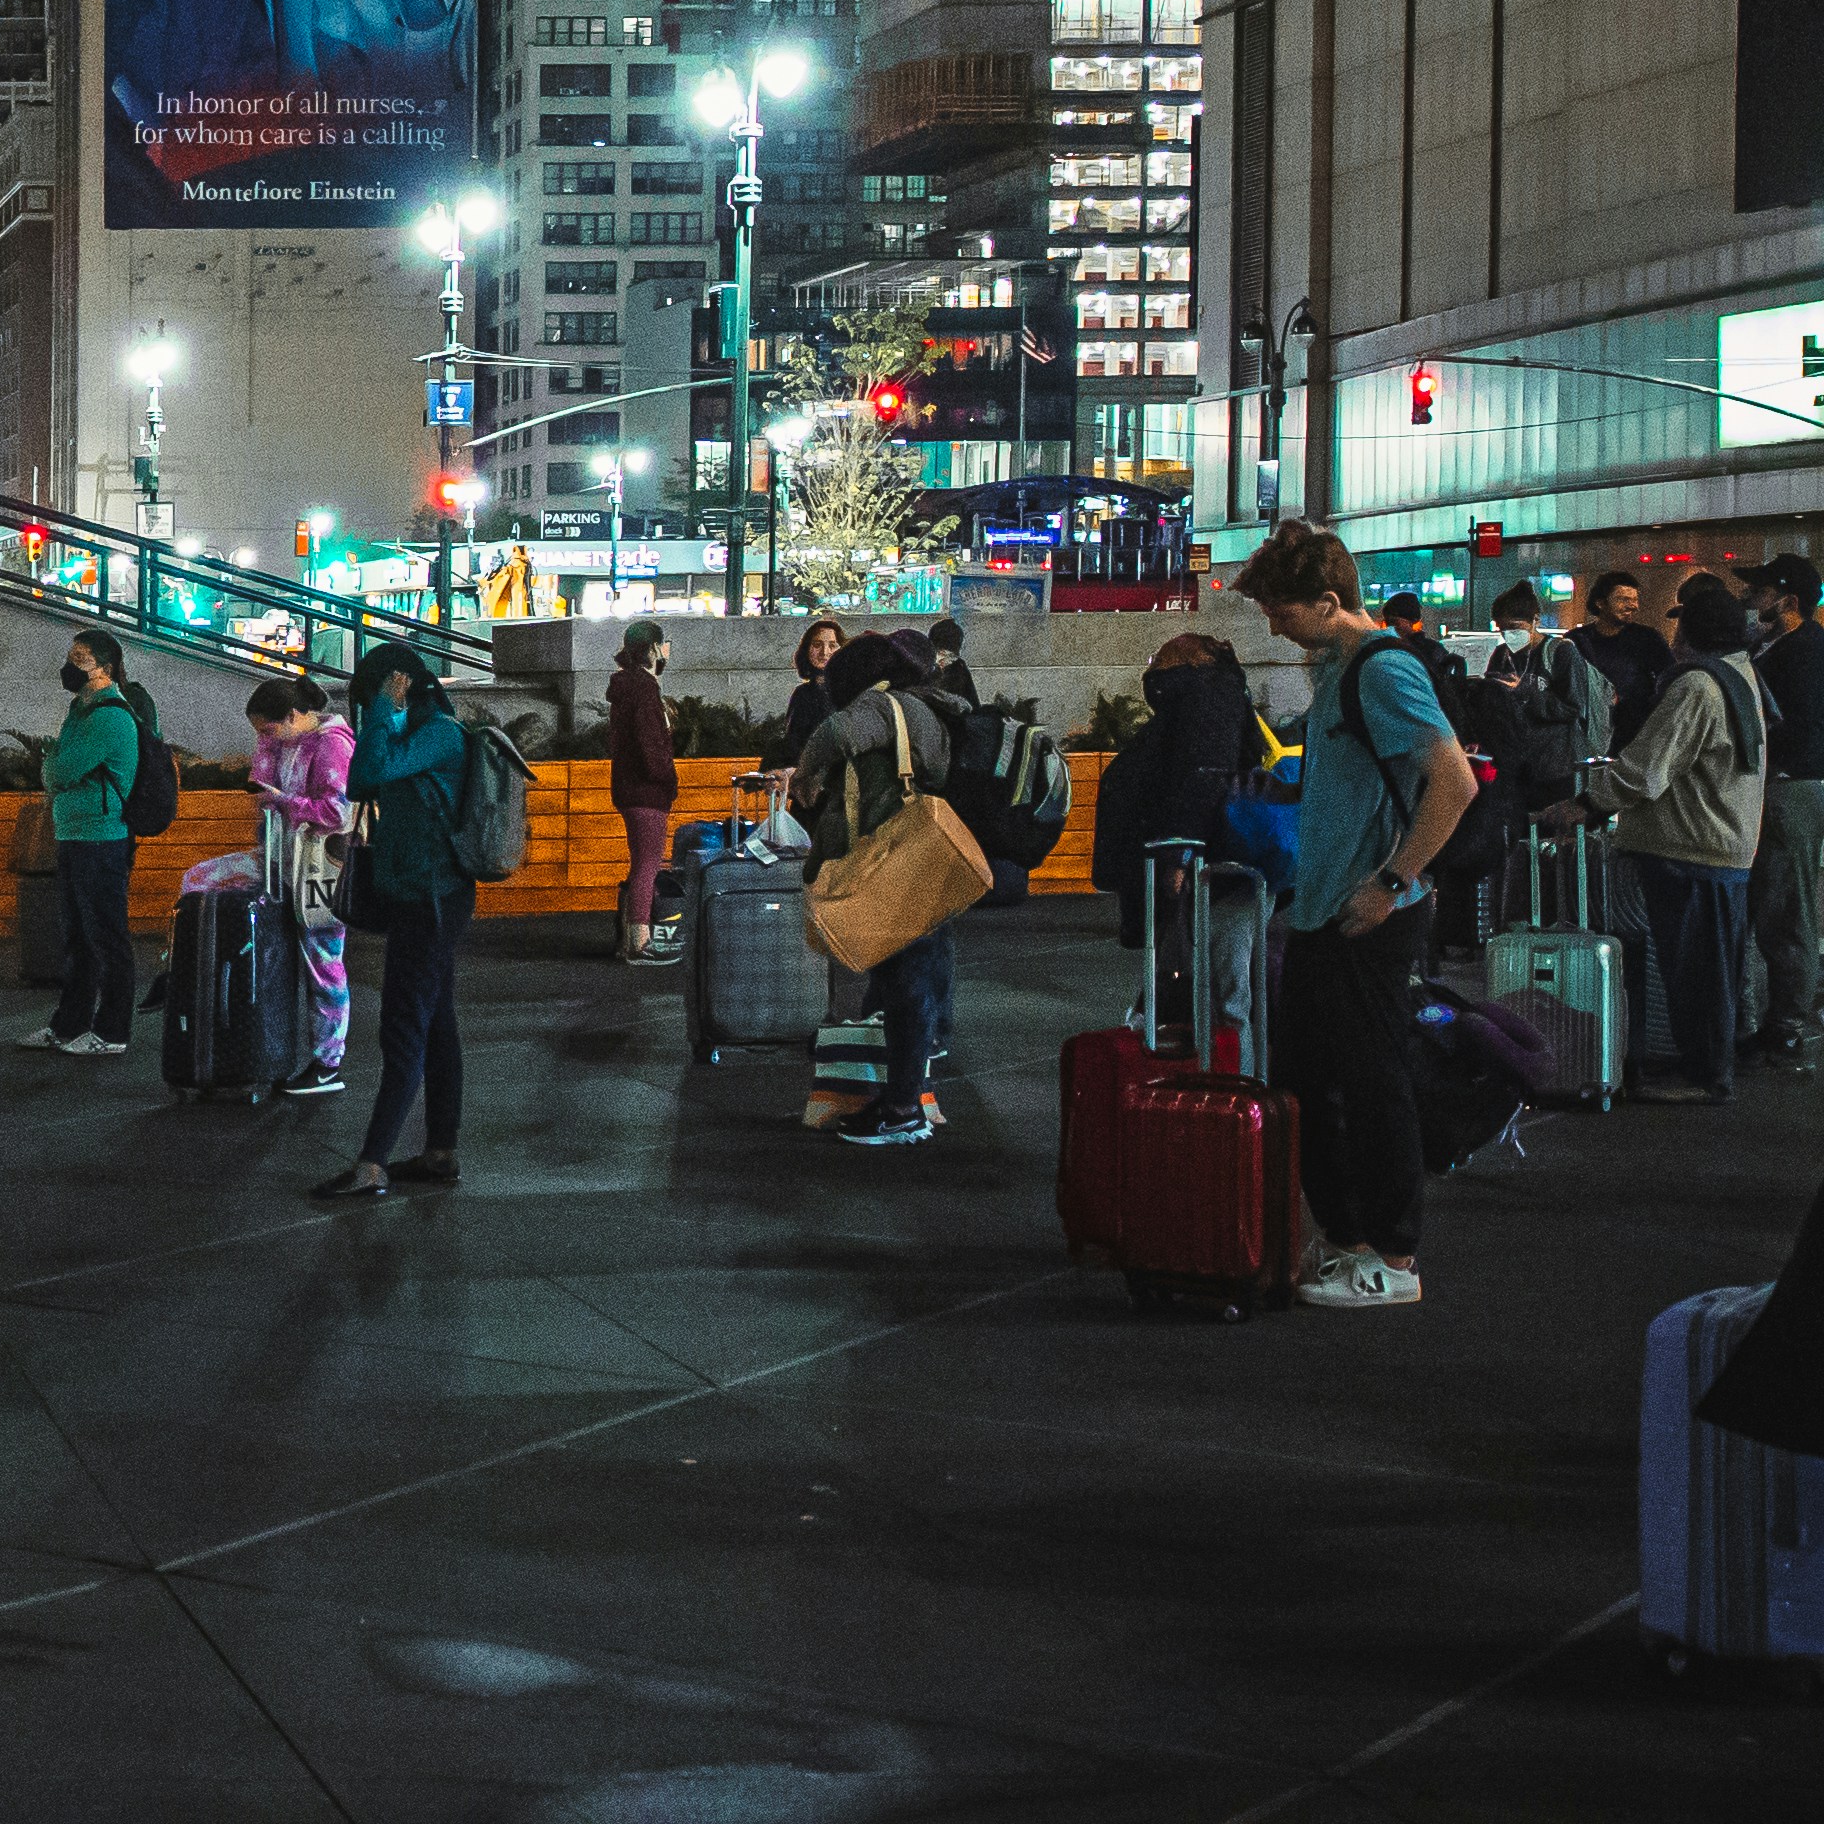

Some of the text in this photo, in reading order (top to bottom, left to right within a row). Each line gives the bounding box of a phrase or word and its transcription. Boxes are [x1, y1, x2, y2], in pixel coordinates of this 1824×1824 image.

[156, 91, 183, 115] In
[189, 90, 263, 116] honor
[269, 90, 297, 115] of
[299, 90, 329, 115] all
[134, 120, 447, 152] for whom care is a calling
[182, 179, 397, 202] Montefiore Einstein
[544, 513, 601, 524] PARKING
[653, 924, 678, 940] EY
